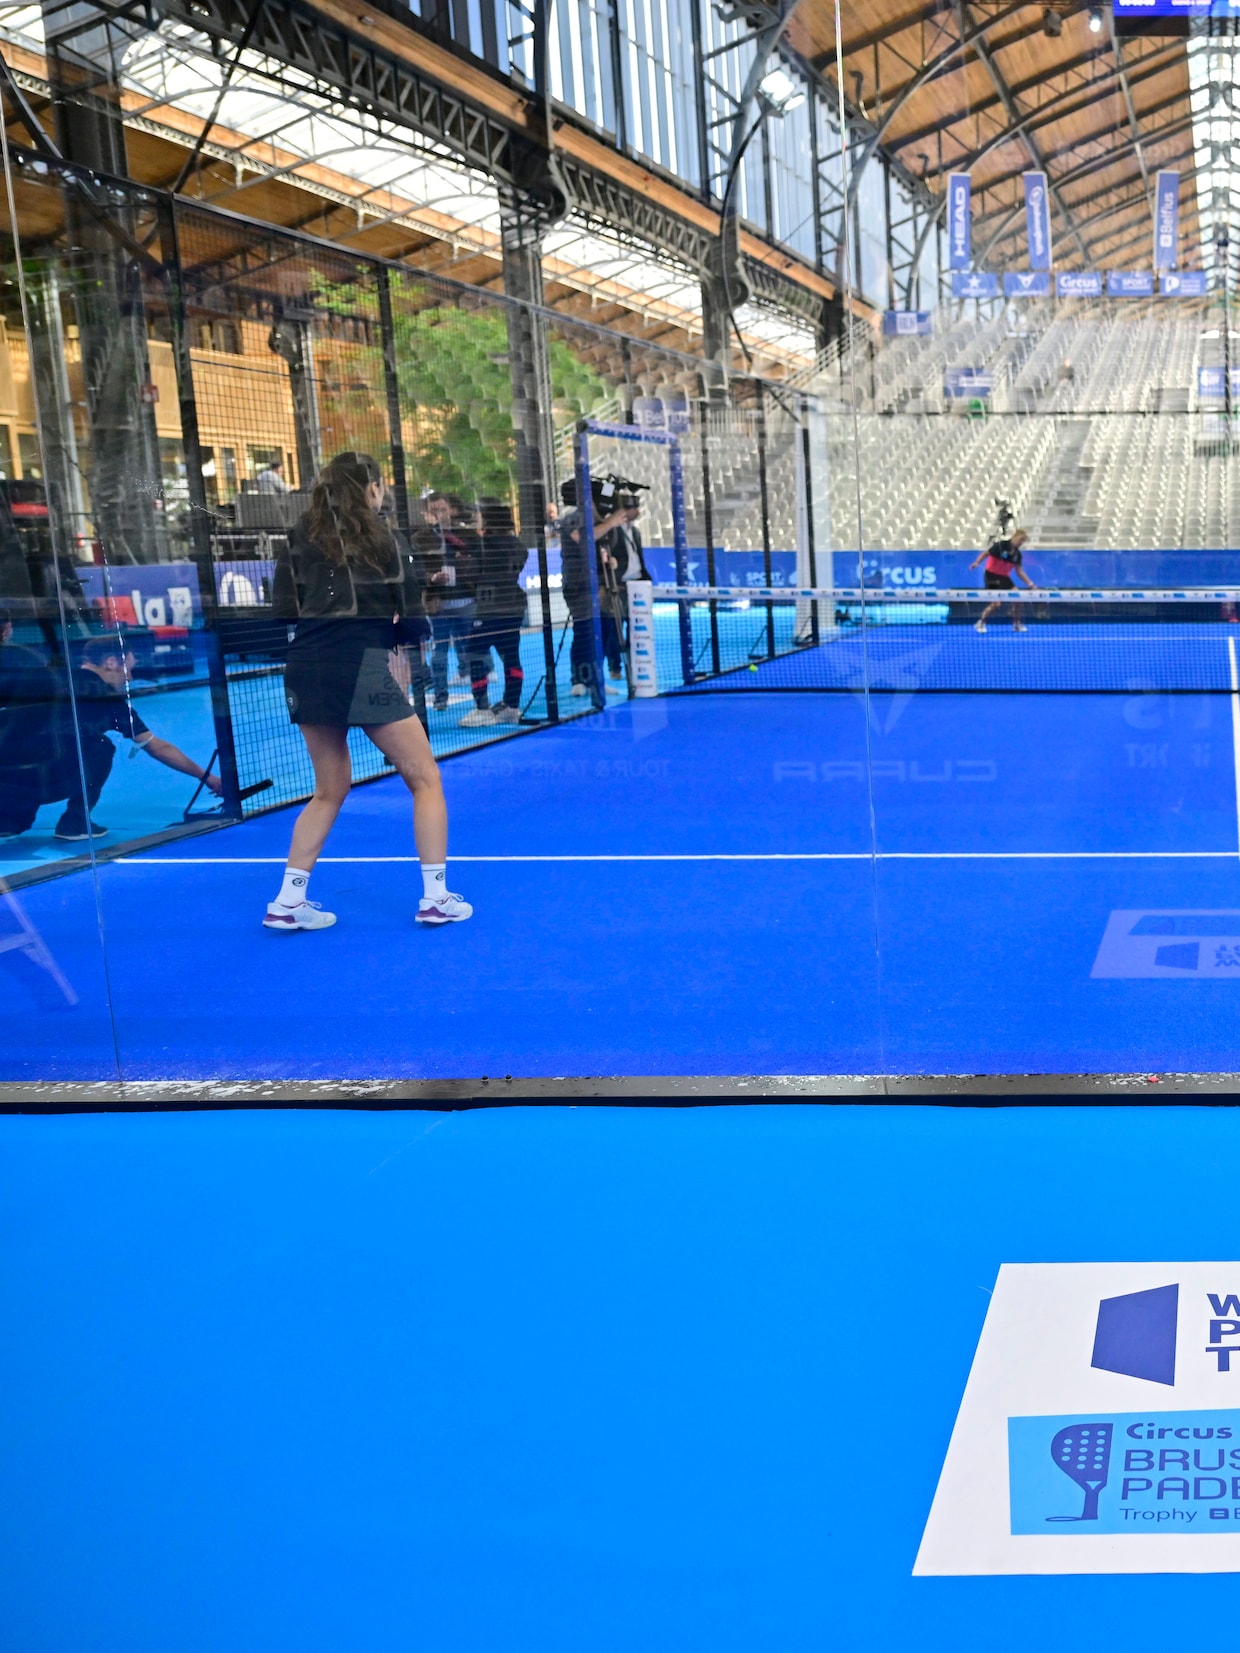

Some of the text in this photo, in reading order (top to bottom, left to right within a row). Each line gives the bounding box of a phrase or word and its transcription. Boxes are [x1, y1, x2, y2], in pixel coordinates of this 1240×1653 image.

[953, 186, 967, 257] HEAD
[1059, 275, 1098, 288] Circus
[856, 560, 937, 585] Crcus
[1126, 1422, 1233, 1440] Circus
[1120, 1507, 1198, 1523] Trophy
